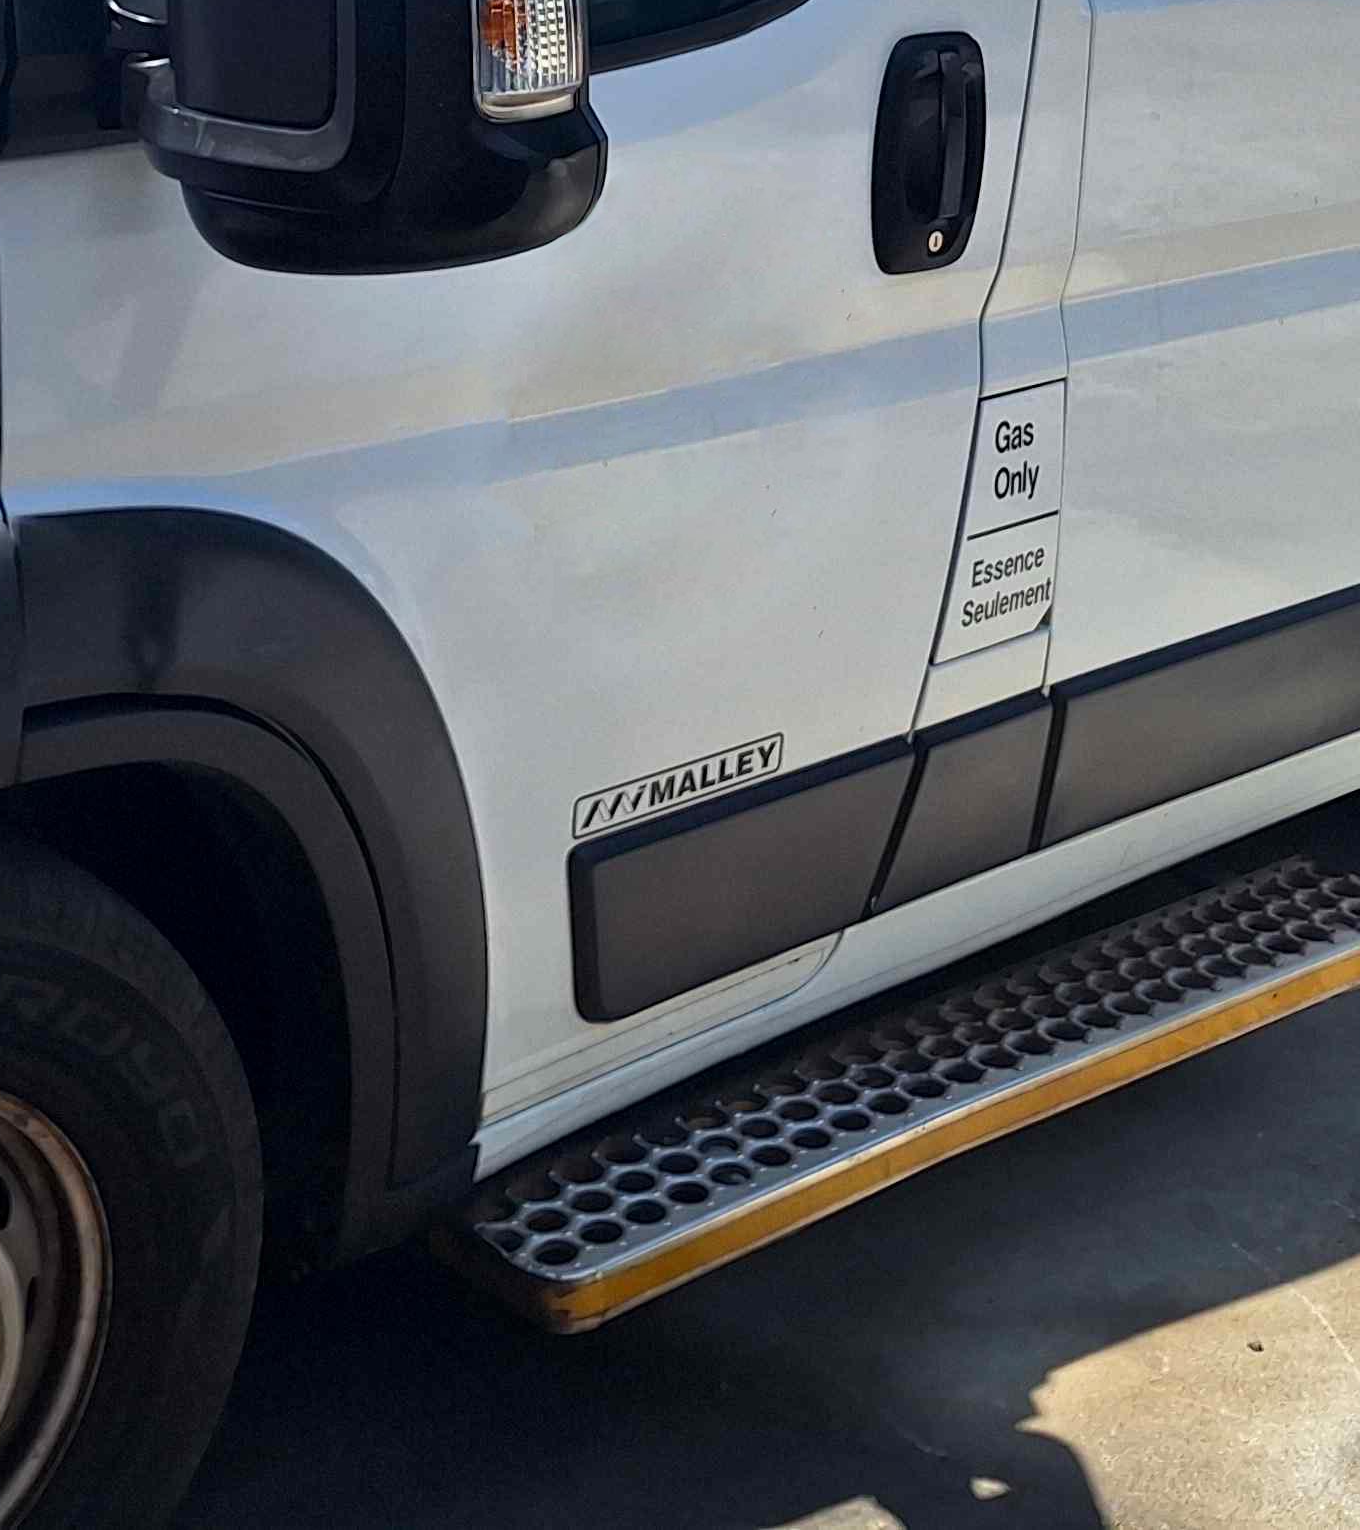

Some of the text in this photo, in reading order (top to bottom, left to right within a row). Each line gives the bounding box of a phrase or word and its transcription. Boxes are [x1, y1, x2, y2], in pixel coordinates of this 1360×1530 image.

[994, 420, 1034, 454] Gas
[993, 460, 1040, 500] Only
[971, 546, 1045, 588] Essence
[960, 576, 1052, 628] Seulement
[648, 740, 778, 808] MALLEY
